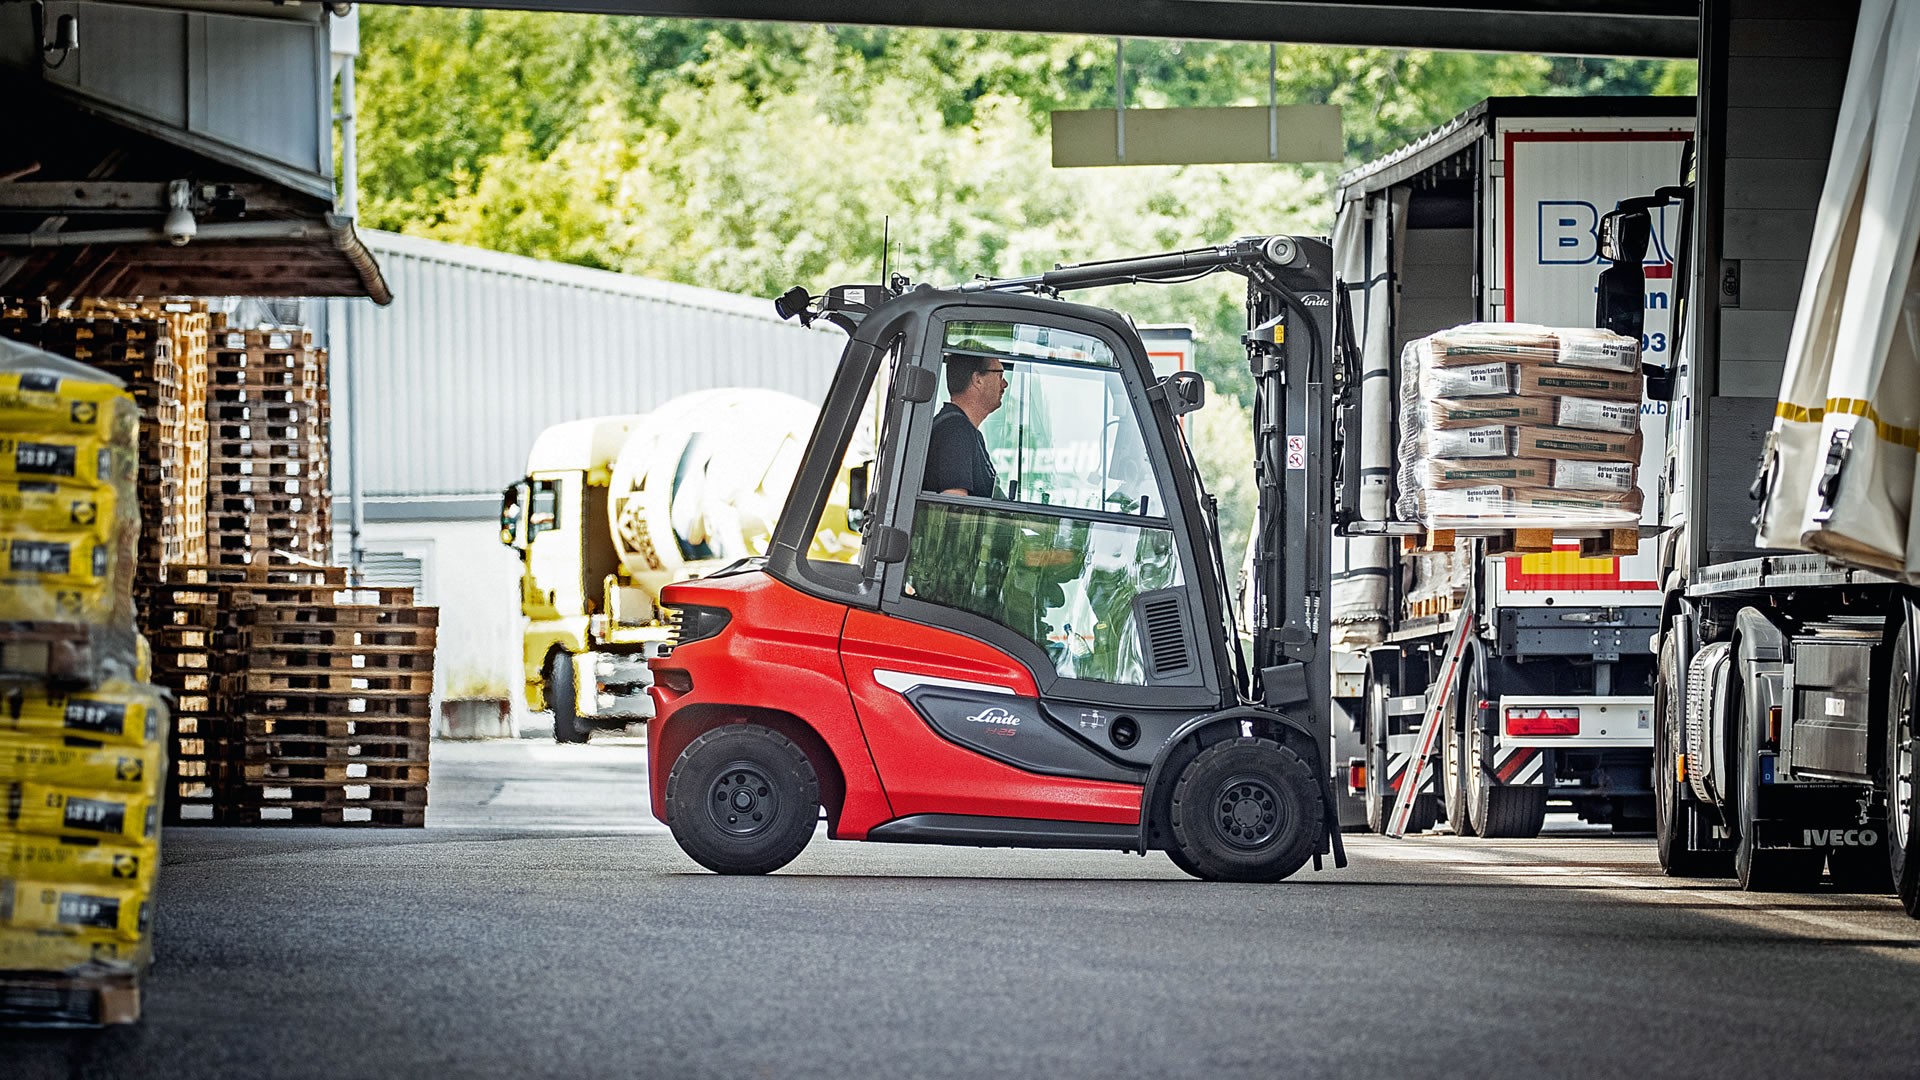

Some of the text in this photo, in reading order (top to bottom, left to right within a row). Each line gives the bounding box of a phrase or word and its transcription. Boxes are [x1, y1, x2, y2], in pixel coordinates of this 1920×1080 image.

[1602, 343, 1636, 352] Beton/Estrich
[1470, 367, 1504, 375] Beton/Estrich
[1602, 405, 1635, 414] Beton/Estrich
[1597, 465, 1630, 473] Beton/Estrich
[966, 707, 1021, 726] Linde
[1803, 829, 1878, 846] IVECO
